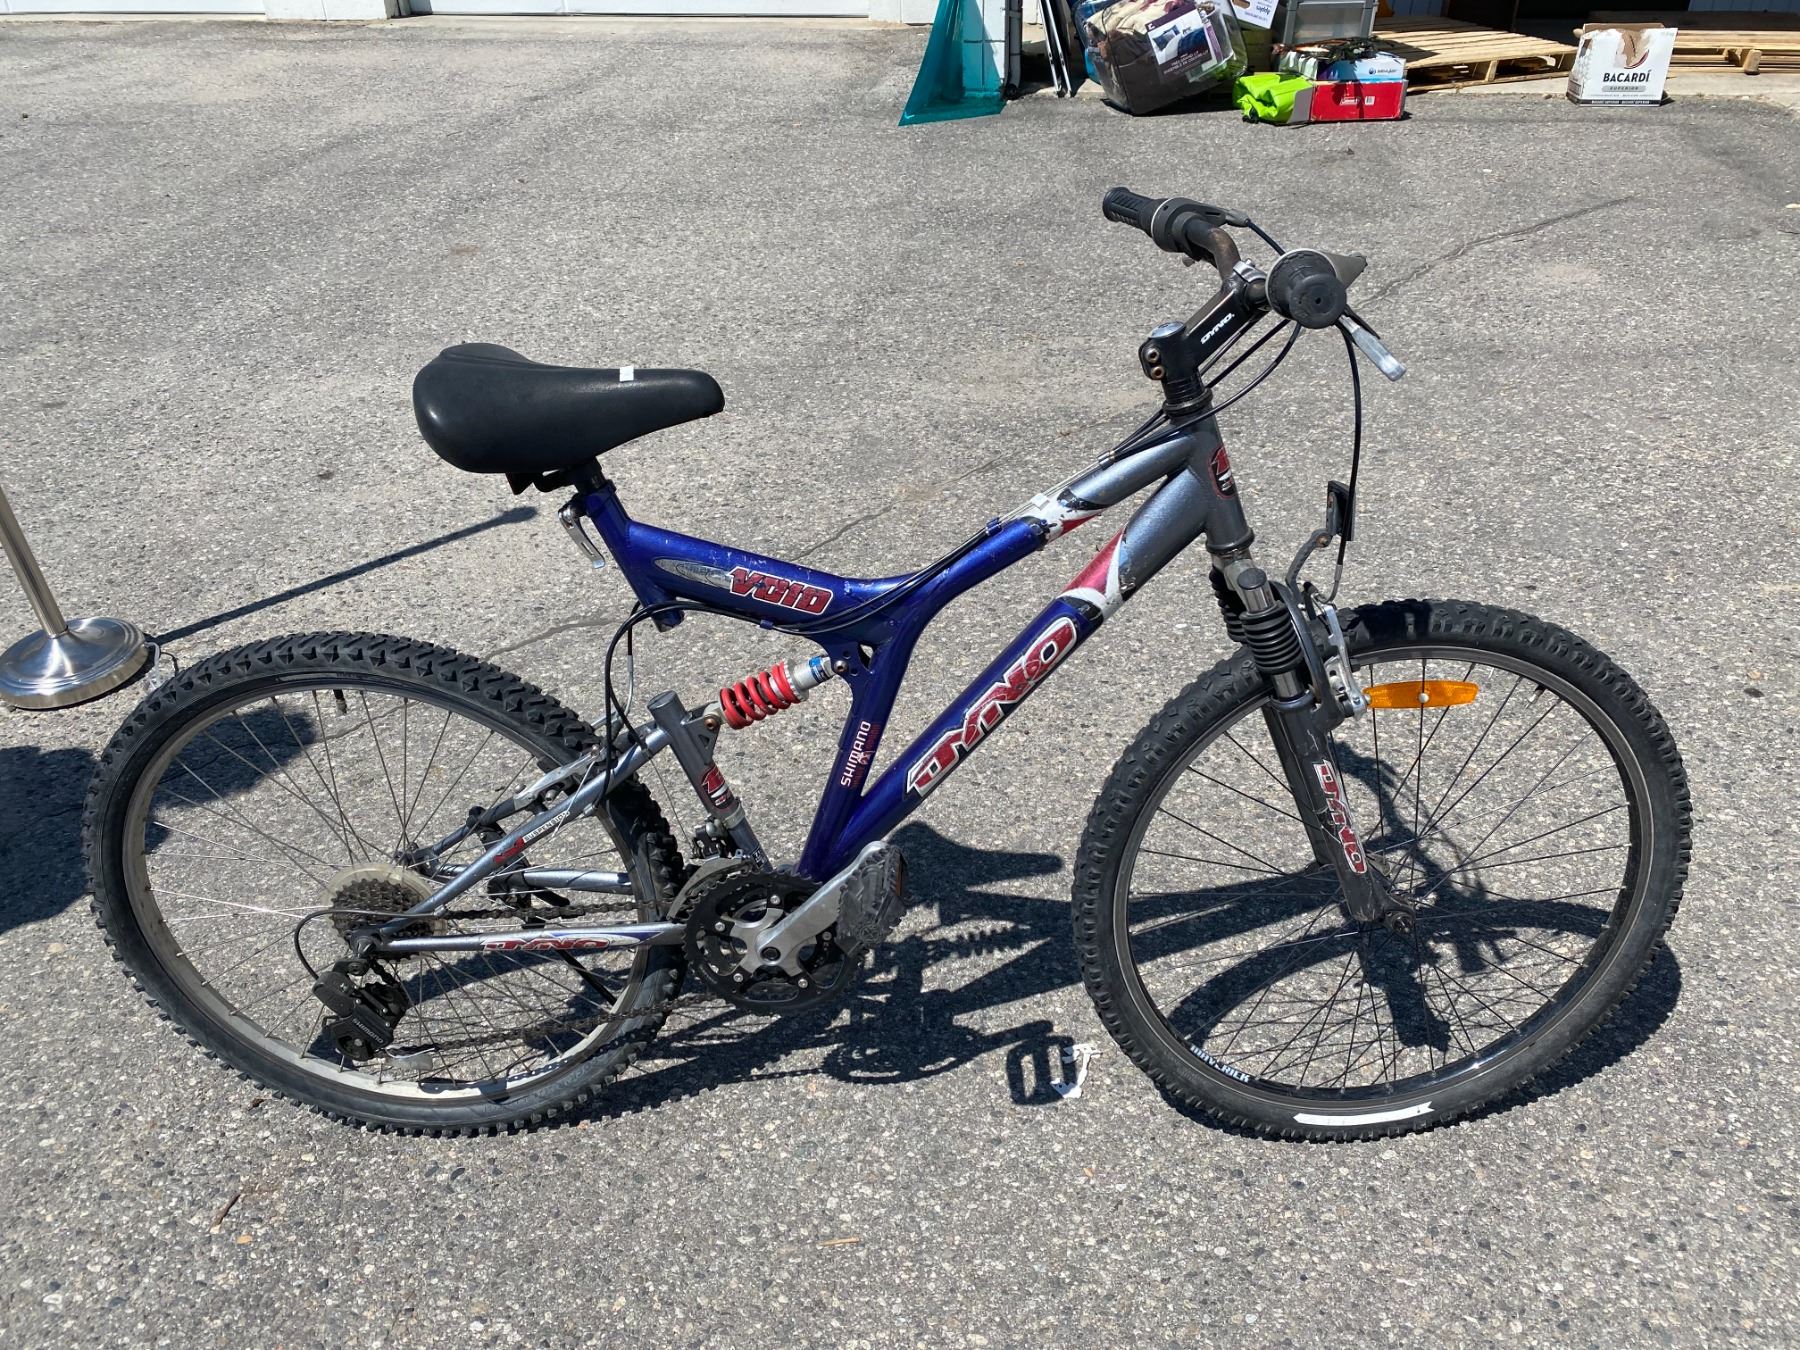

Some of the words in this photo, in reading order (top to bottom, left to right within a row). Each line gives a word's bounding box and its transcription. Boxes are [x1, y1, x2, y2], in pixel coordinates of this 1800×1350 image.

[1603, 69, 1652, 83] BACARDÍ
[726, 566, 834, 616] VOID
[906, 616, 1078, 798] DYNO
[840, 720, 872, 787] SHIMANO
